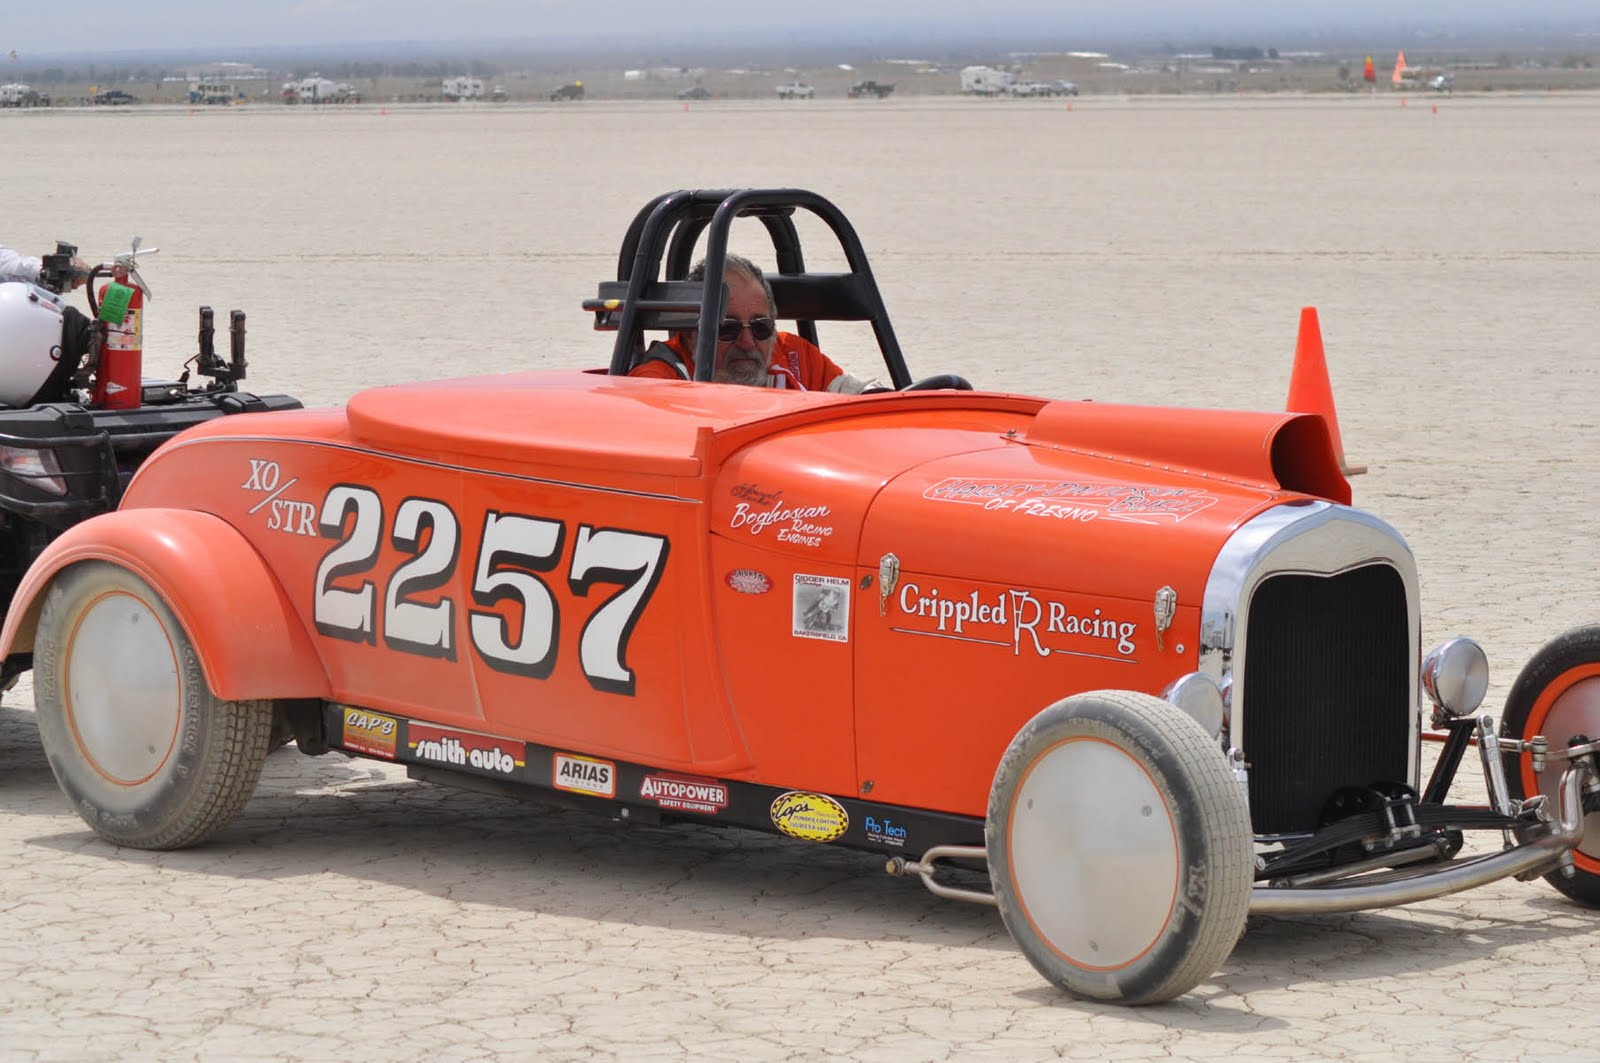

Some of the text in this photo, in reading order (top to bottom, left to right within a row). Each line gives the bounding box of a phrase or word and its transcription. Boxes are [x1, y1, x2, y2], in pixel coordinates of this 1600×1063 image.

[267, 499, 317, 537] STR
[730, 500, 832, 535] Boghosian
[983, 497, 1099, 522] OF FRESNO
[776, 528, 823, 547] ENGINES
[791, 519, 834, 537] RACING
[314, 484, 670, 697] 2257
[826, 578, 850, 586] HELM
[899, 583, 1008, 634] Crippled
[1047, 601, 1137, 656] Racing
[346, 711, 394, 735] CAP'S
[415, 736, 466, 765] smith
[469, 747, 515, 773] auto
[560, 761, 609, 784] ARIAS
[640, 776, 725, 803] AUTOPOWER
[660, 799, 716, 812] SAFETY EQUIPMENT
[883, 819, 907, 838] Tech
